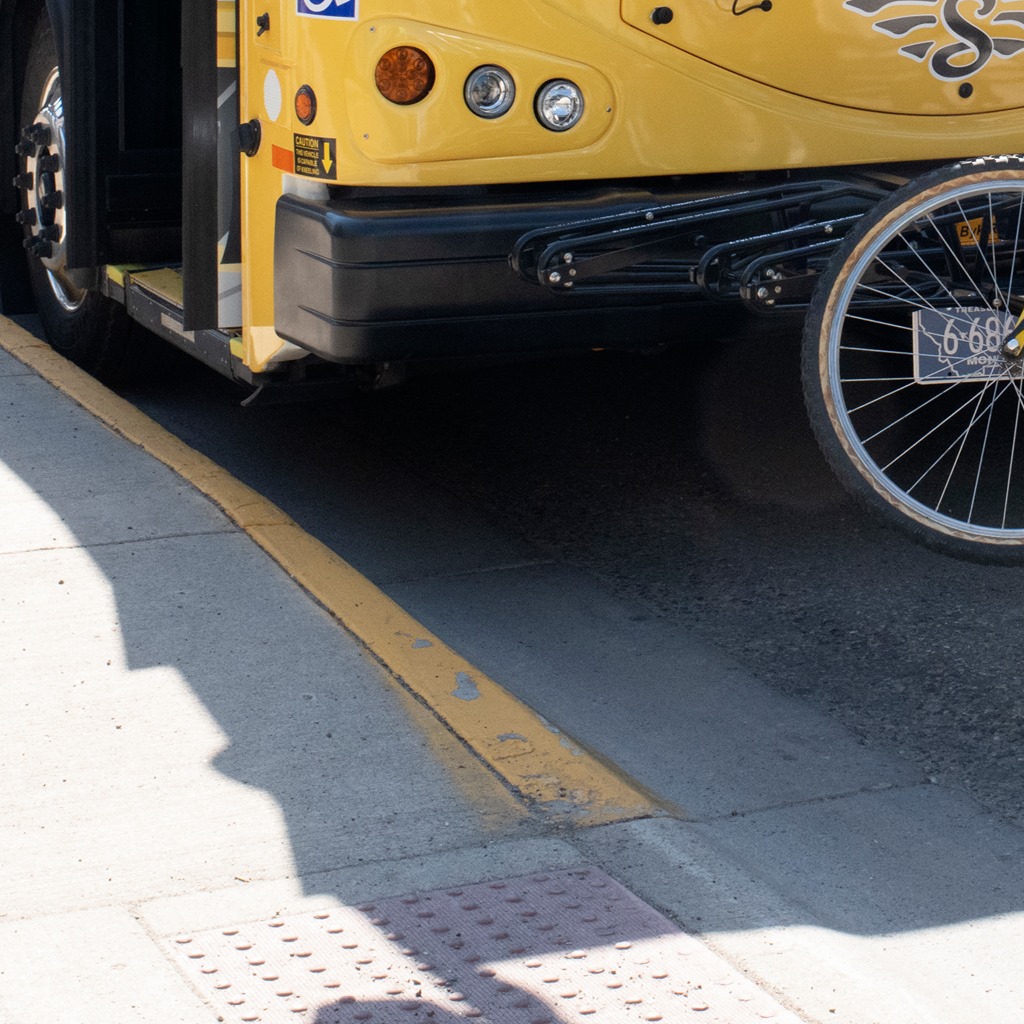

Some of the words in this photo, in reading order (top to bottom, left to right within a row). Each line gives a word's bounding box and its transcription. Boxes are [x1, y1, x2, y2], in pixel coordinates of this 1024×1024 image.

[295, 136, 319, 148] CAUTION
[304, 150, 319, 159] VEHICLE
[301, 158, 318, 167] CAPABLE
[301, 166, 319, 175] KNEELING
